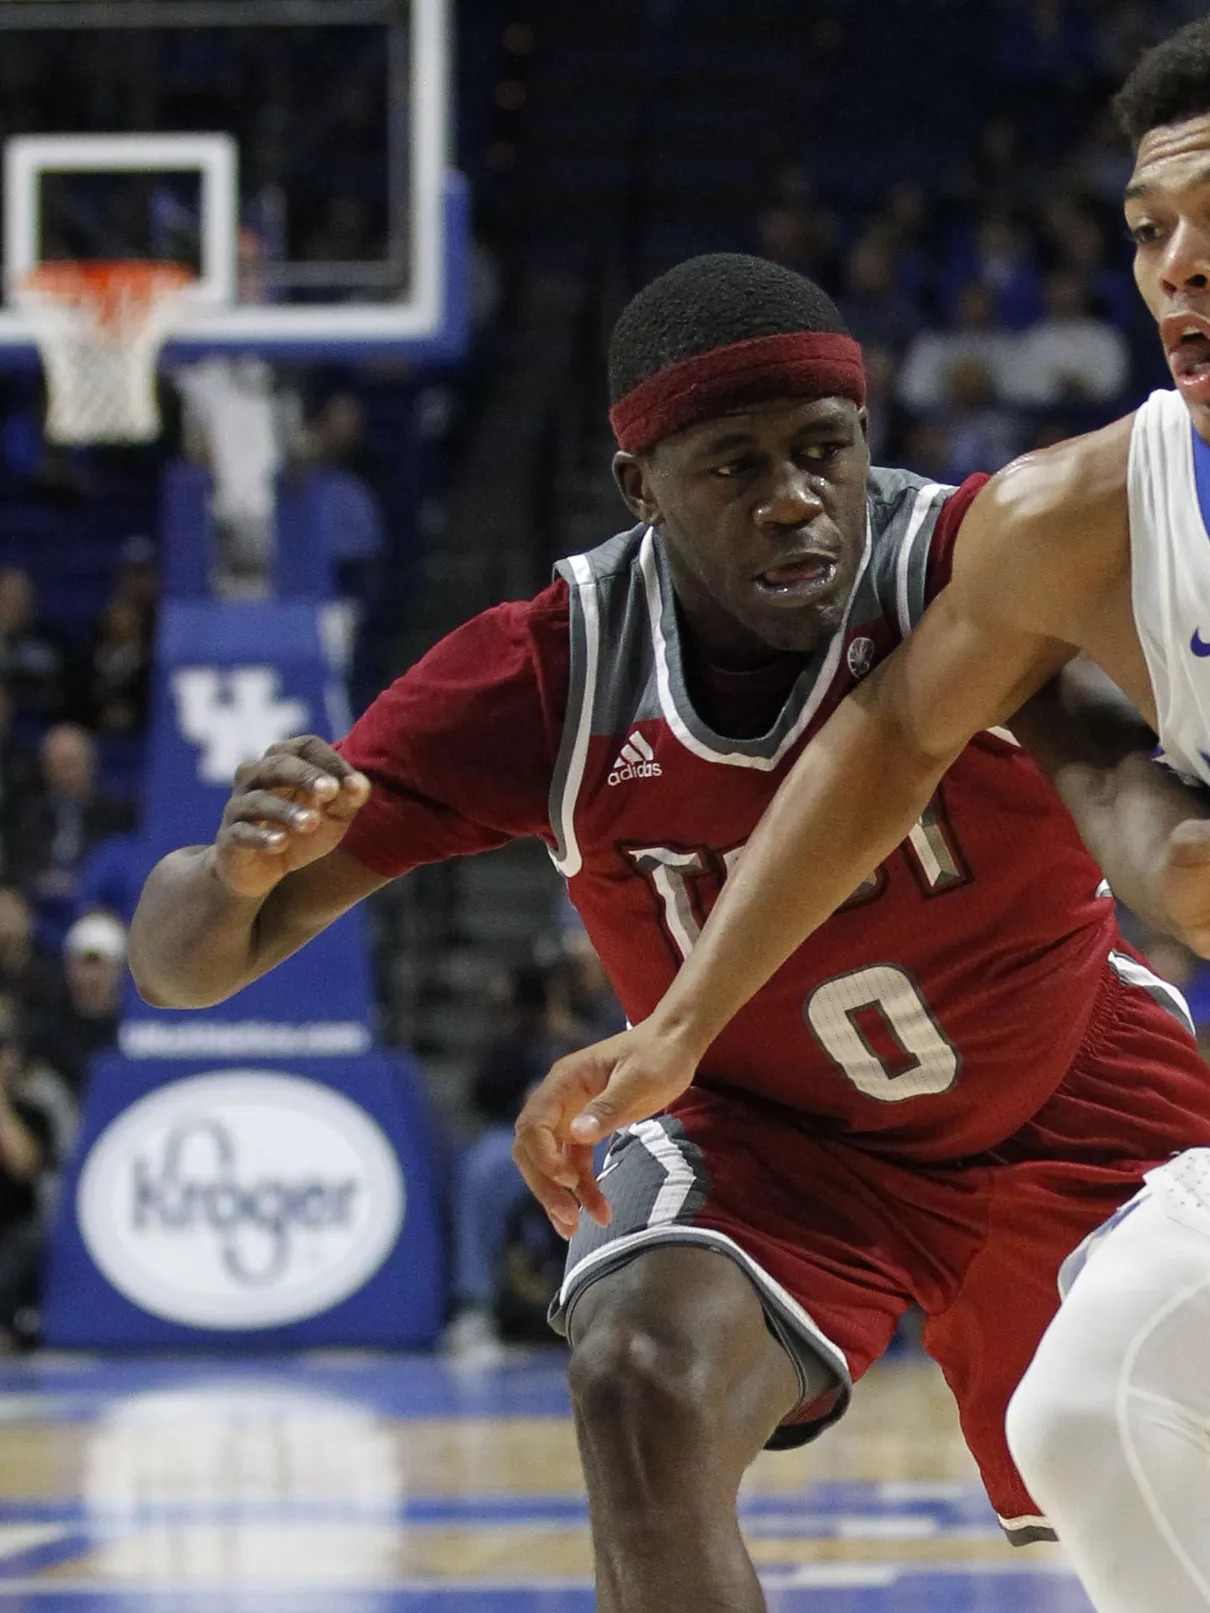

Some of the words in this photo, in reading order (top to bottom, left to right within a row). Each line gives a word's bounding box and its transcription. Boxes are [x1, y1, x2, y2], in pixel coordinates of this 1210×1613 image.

[608, 760, 662, 786] adidas
[807, 963, 959, 1102] 0
[132, 1116, 358, 1287] Kroger
